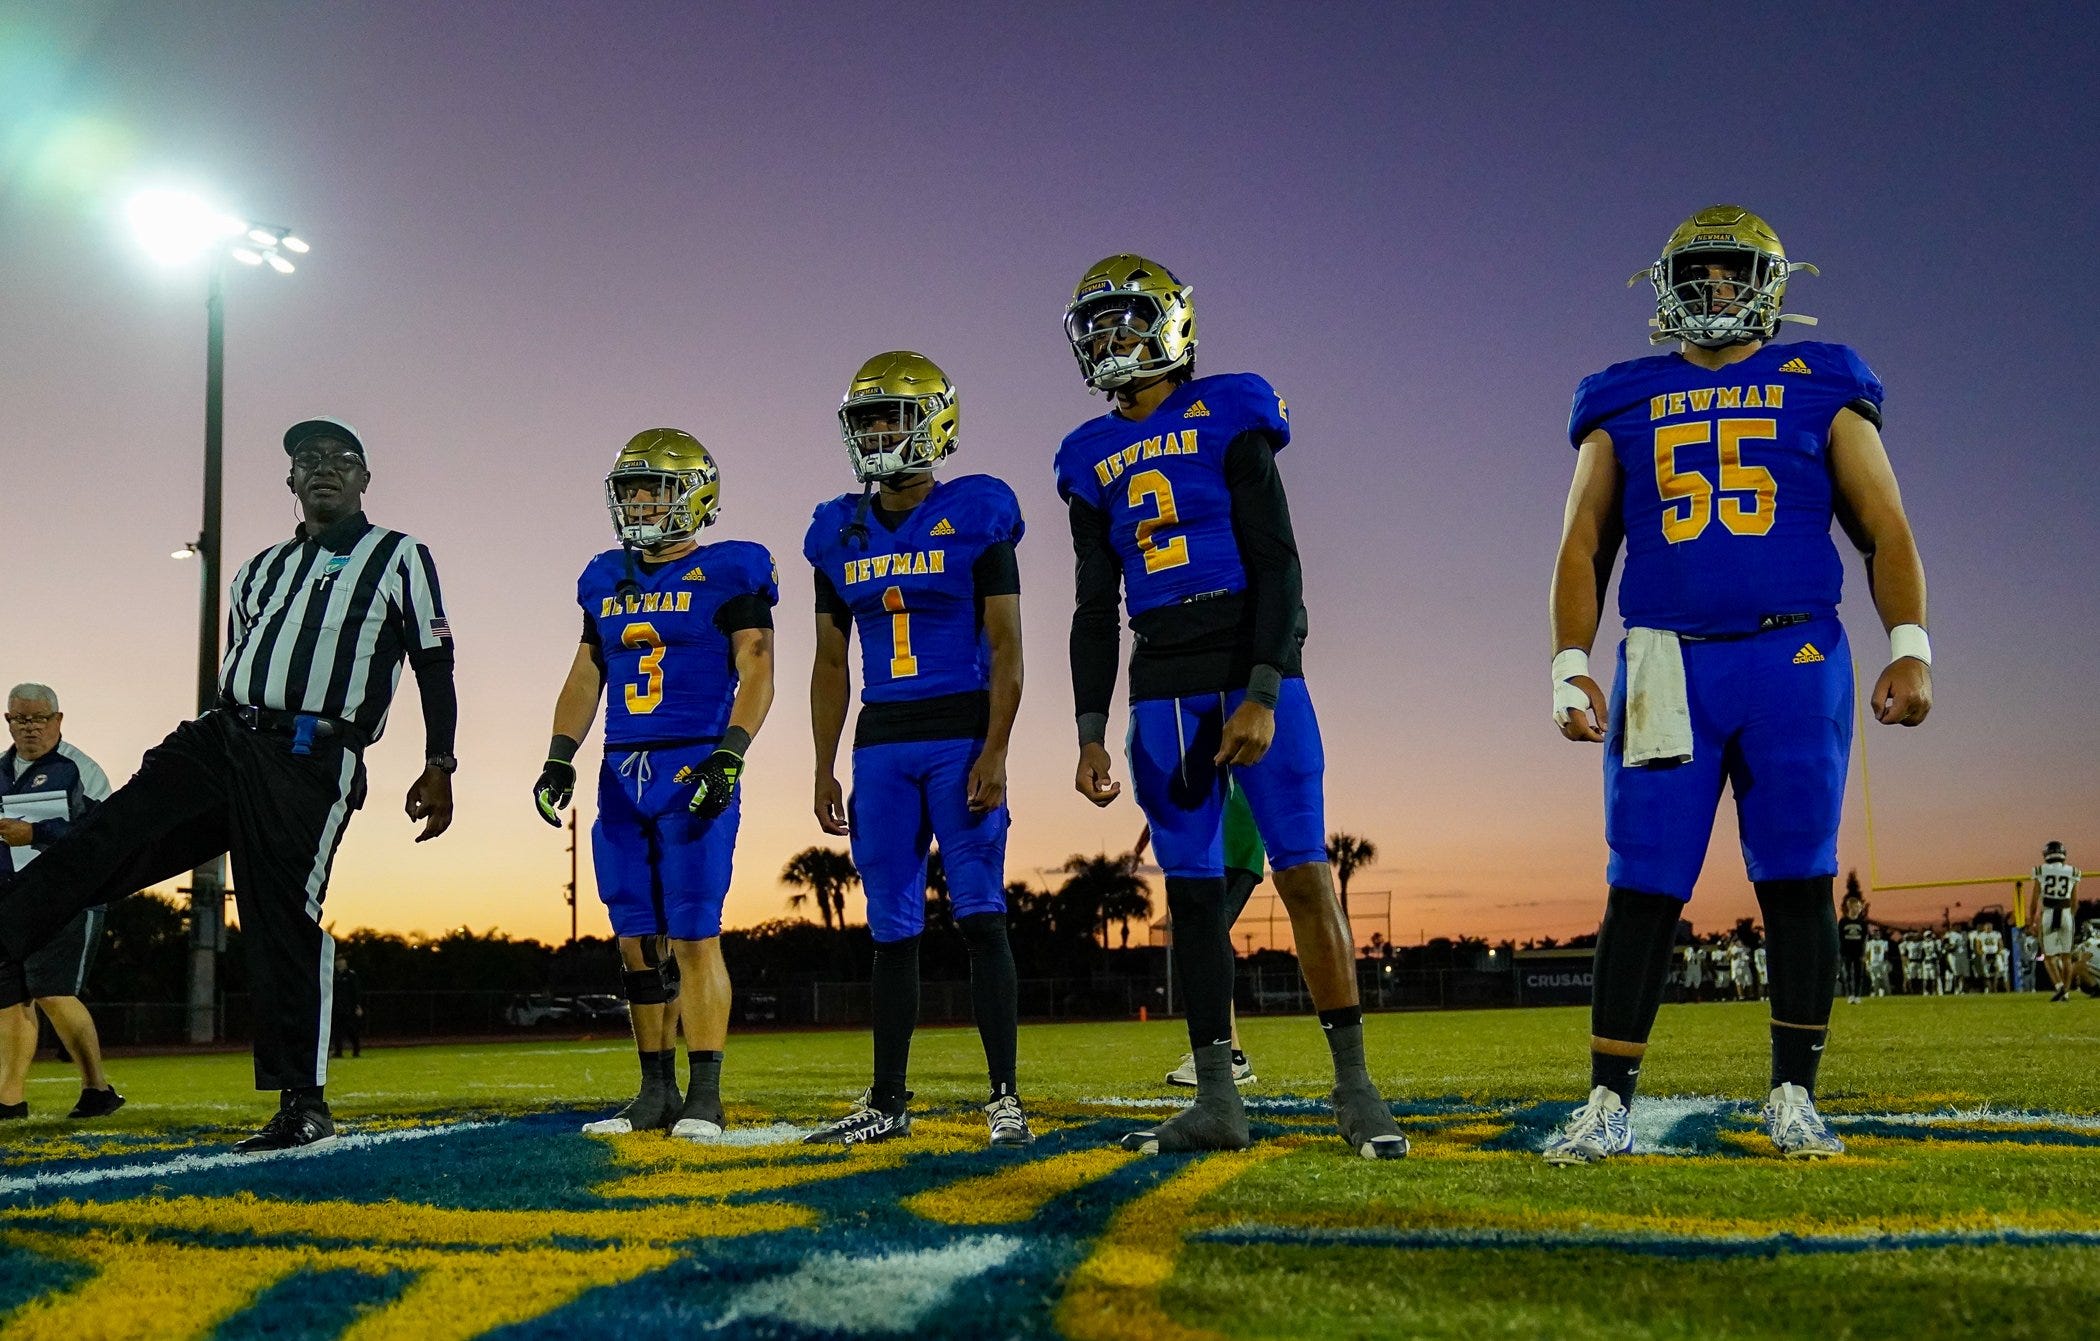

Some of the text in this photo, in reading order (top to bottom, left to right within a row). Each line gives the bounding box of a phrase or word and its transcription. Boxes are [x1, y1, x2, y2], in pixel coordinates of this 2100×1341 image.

[1779, 367, 1812, 375] adidas
[1183, 410, 1210, 418] adidas
[1650, 385, 1784, 420] NEWMAN
[1094, 429, 1198, 487] NEWMAN
[1654, 418, 1778, 544] 55
[929, 527, 955, 536] adidas
[1128, 469, 1190, 575] 2
[845, 550, 945, 585] NEWMAN
[882, 586, 918, 679] 1
[621, 622, 666, 715] 3
[1792, 655, 1825, 664] adidas
[2044, 875, 2069, 897] 23
[845, 1116, 894, 1144] BATTLE
